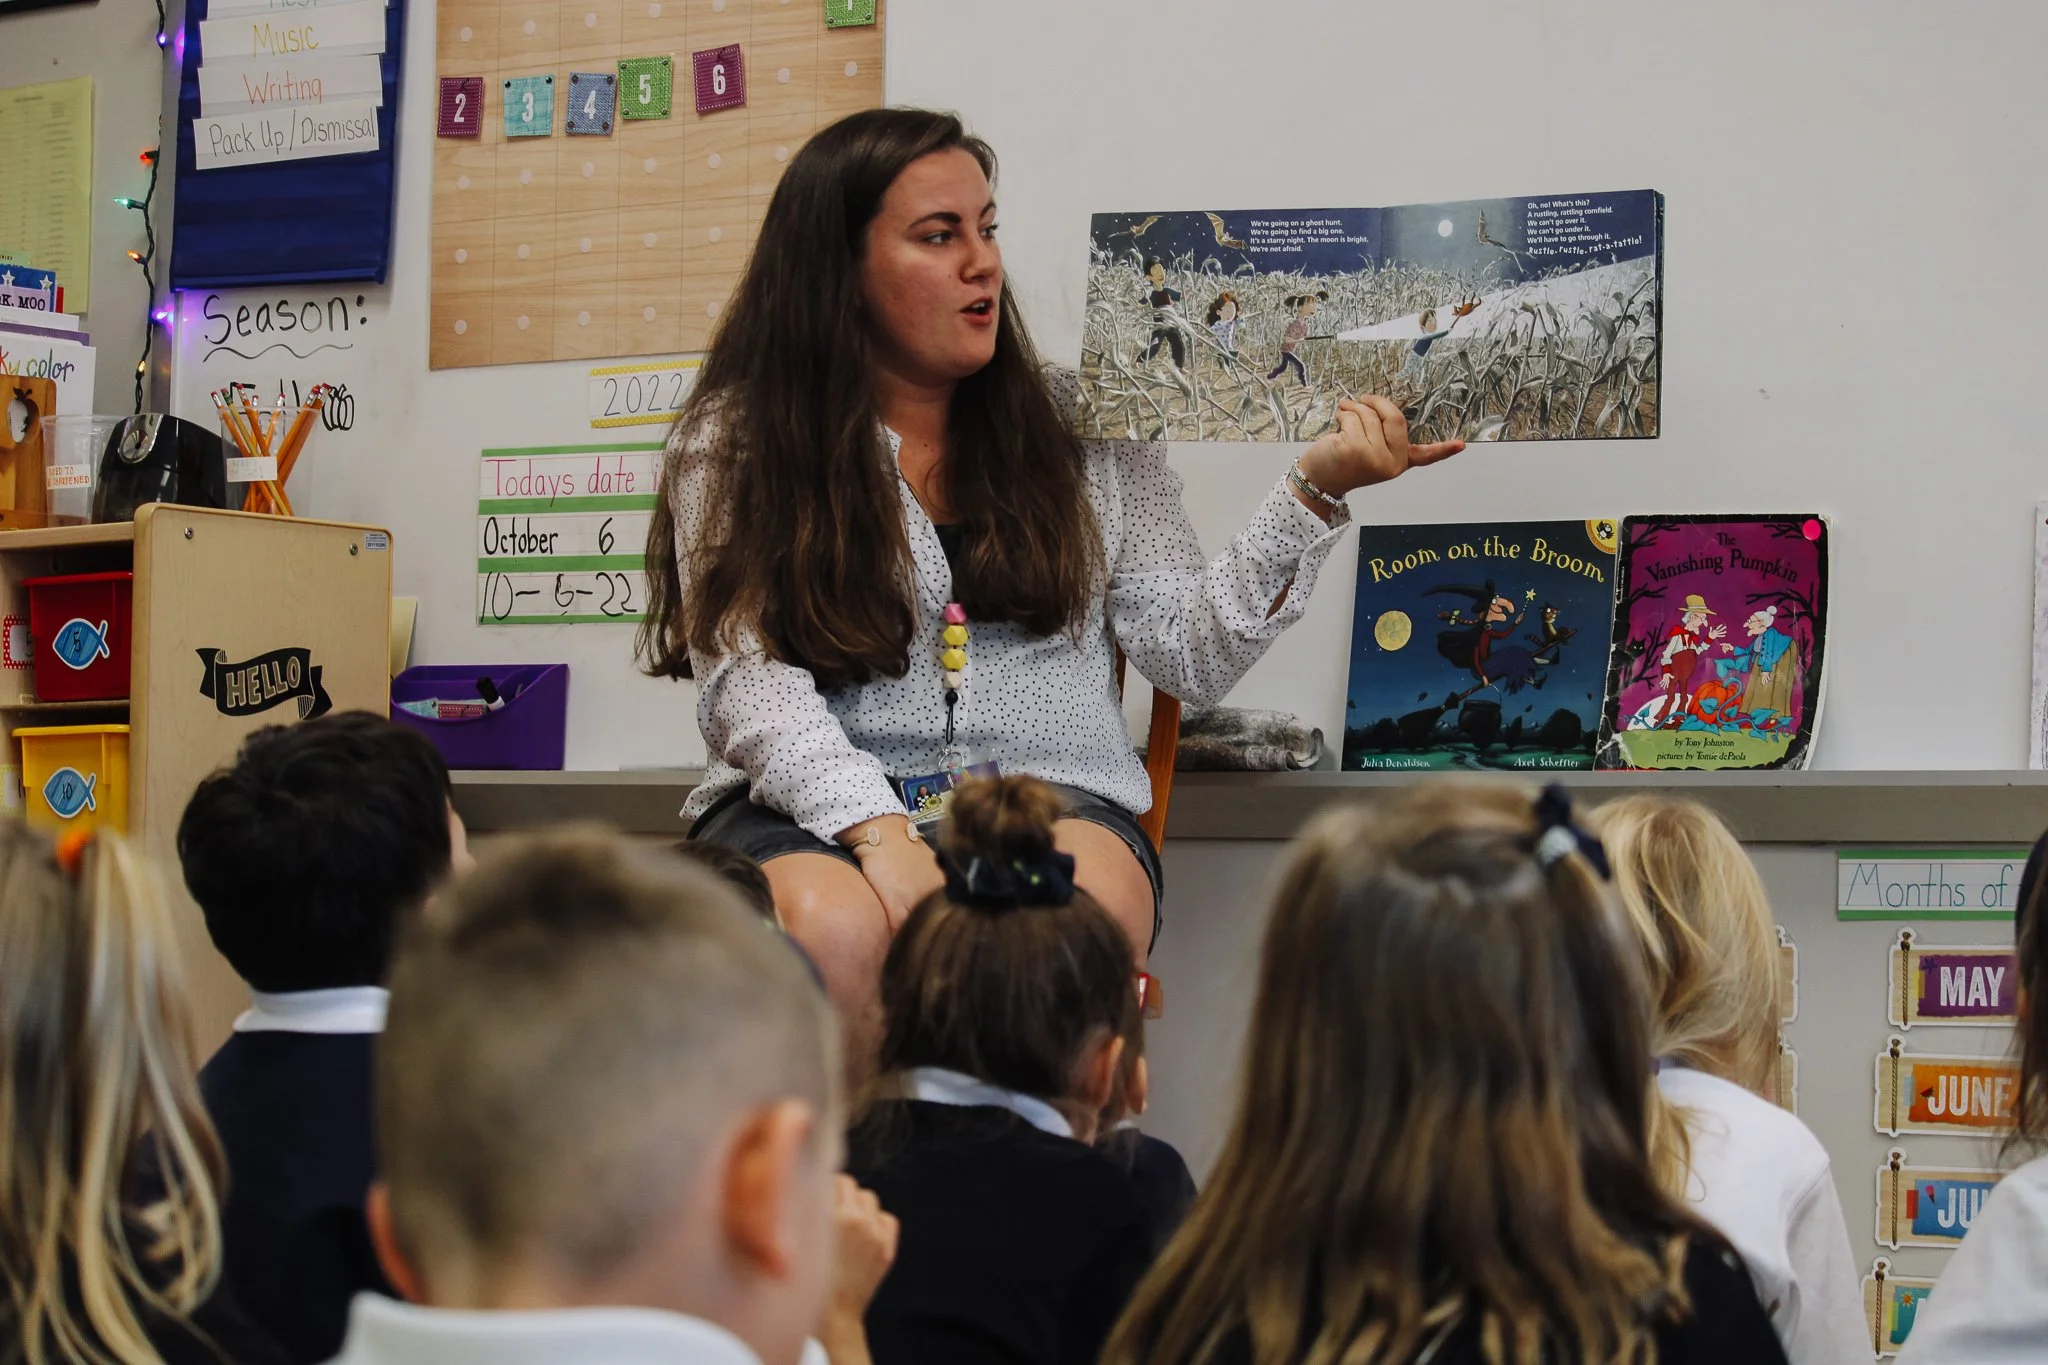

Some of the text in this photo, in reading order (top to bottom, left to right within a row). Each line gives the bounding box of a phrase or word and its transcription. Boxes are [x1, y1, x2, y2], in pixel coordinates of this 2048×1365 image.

[253, 23, 319, 58] Music
[243, 70, 322, 105] Writing
[638, 74, 653, 104] 5
[712, 64, 726, 95] 6
[454, 93, 466, 123] 2
[522, 92, 534, 122] 3
[583, 90, 596, 119] 4
[209, 122, 255, 158] Pack
[1527, 202, 1539, 210] Oh,
[1540, 201, 1551, 209] no!
[1552, 200, 1574, 208] What's
[1560, 208, 1583, 216] rattling
[1584, 207, 1614, 215] cornfield.
[1271, 220, 1289, 228] going
[1271, 229, 1288, 237] going
[1539, 227, 1554, 235] can't
[1555, 227, 1564, 235] go
[1555, 219, 1563, 227] go
[1578, 233, 1603, 242] through
[1287, 237, 1306, 245] night.
[1346, 236, 1369, 244] bright.
[18, 296, 46, 311] MOO
[203, 294, 368, 345] Season:
[26, 348, 75, 382] color
[604, 373, 685, 417] 2022
[64, 466, 74, 475] TO
[484, 458, 575, 507] Todays
[588, 456, 635, 494] date
[483, 516, 614, 555] October 6
[1716, 532, 1736, 546] The
[1368, 548, 1441, 584] Room
[1447, 543, 1478, 560] on
[1483, 535, 1521, 559] the
[1529, 538, 1605, 583] Broom
[1645, 549, 1797, 583] Vanishing Pumpkin
[73, 631, 82, 653] 5
[225, 656, 301, 708] HELLO
[1656, 753, 1684, 762] pictures
[1685, 752, 1694, 762] by
[1696, 752, 1718, 760] Tomie
[1674, 737, 1735, 749] by Tony Johnston
[1361, 757, 1431, 769] Julia Donaldson
[1514, 757, 1580, 768] Axel Scheffler
[62, 782, 73, 800] 10
[1846, 863, 1965, 908] Months
[1981, 864, 2014, 908] of
[1939, 966, 2005, 1007] MAY
[1927, 1075, 2012, 1117] JUNE
